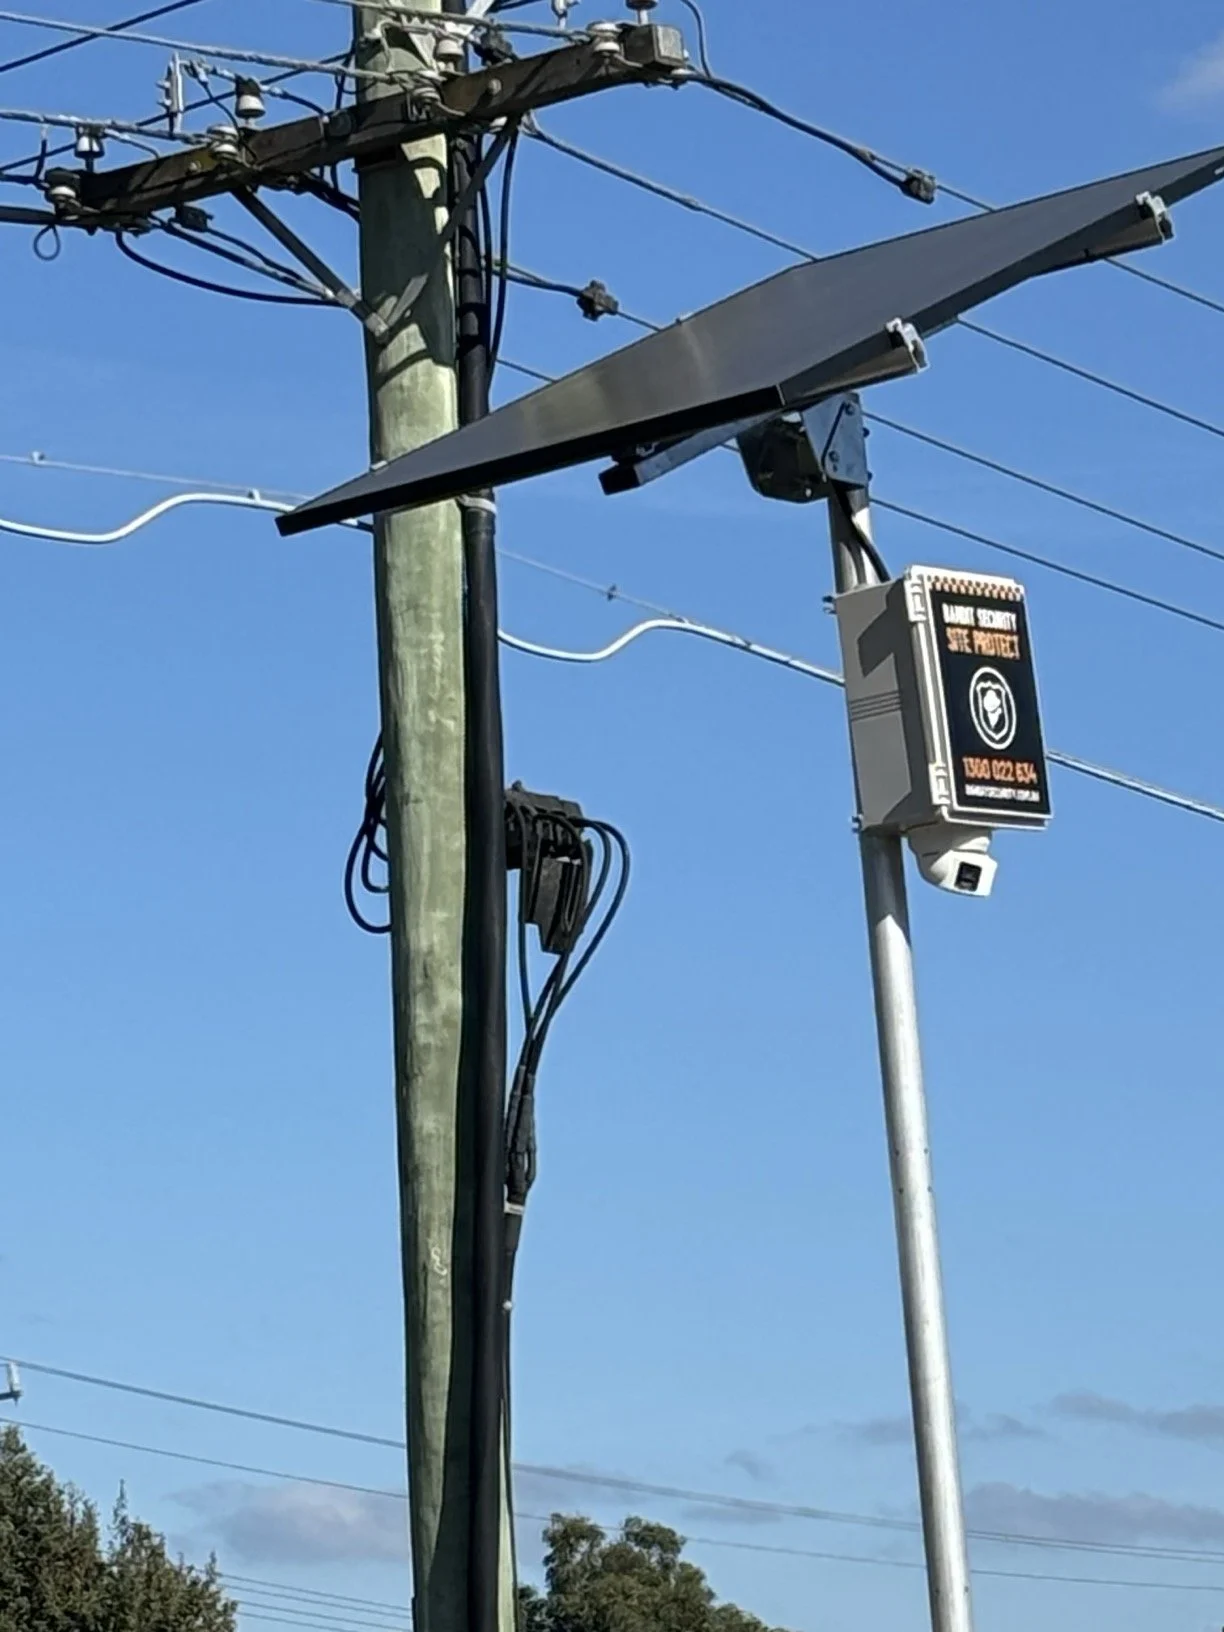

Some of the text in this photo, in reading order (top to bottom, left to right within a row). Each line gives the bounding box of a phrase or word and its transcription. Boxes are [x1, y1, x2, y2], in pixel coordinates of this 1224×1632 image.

[946, 627, 1020, 660] SITE PROTECT
[962, 757, 991, 780] 1300
[992, 759, 1015, 782] 022
